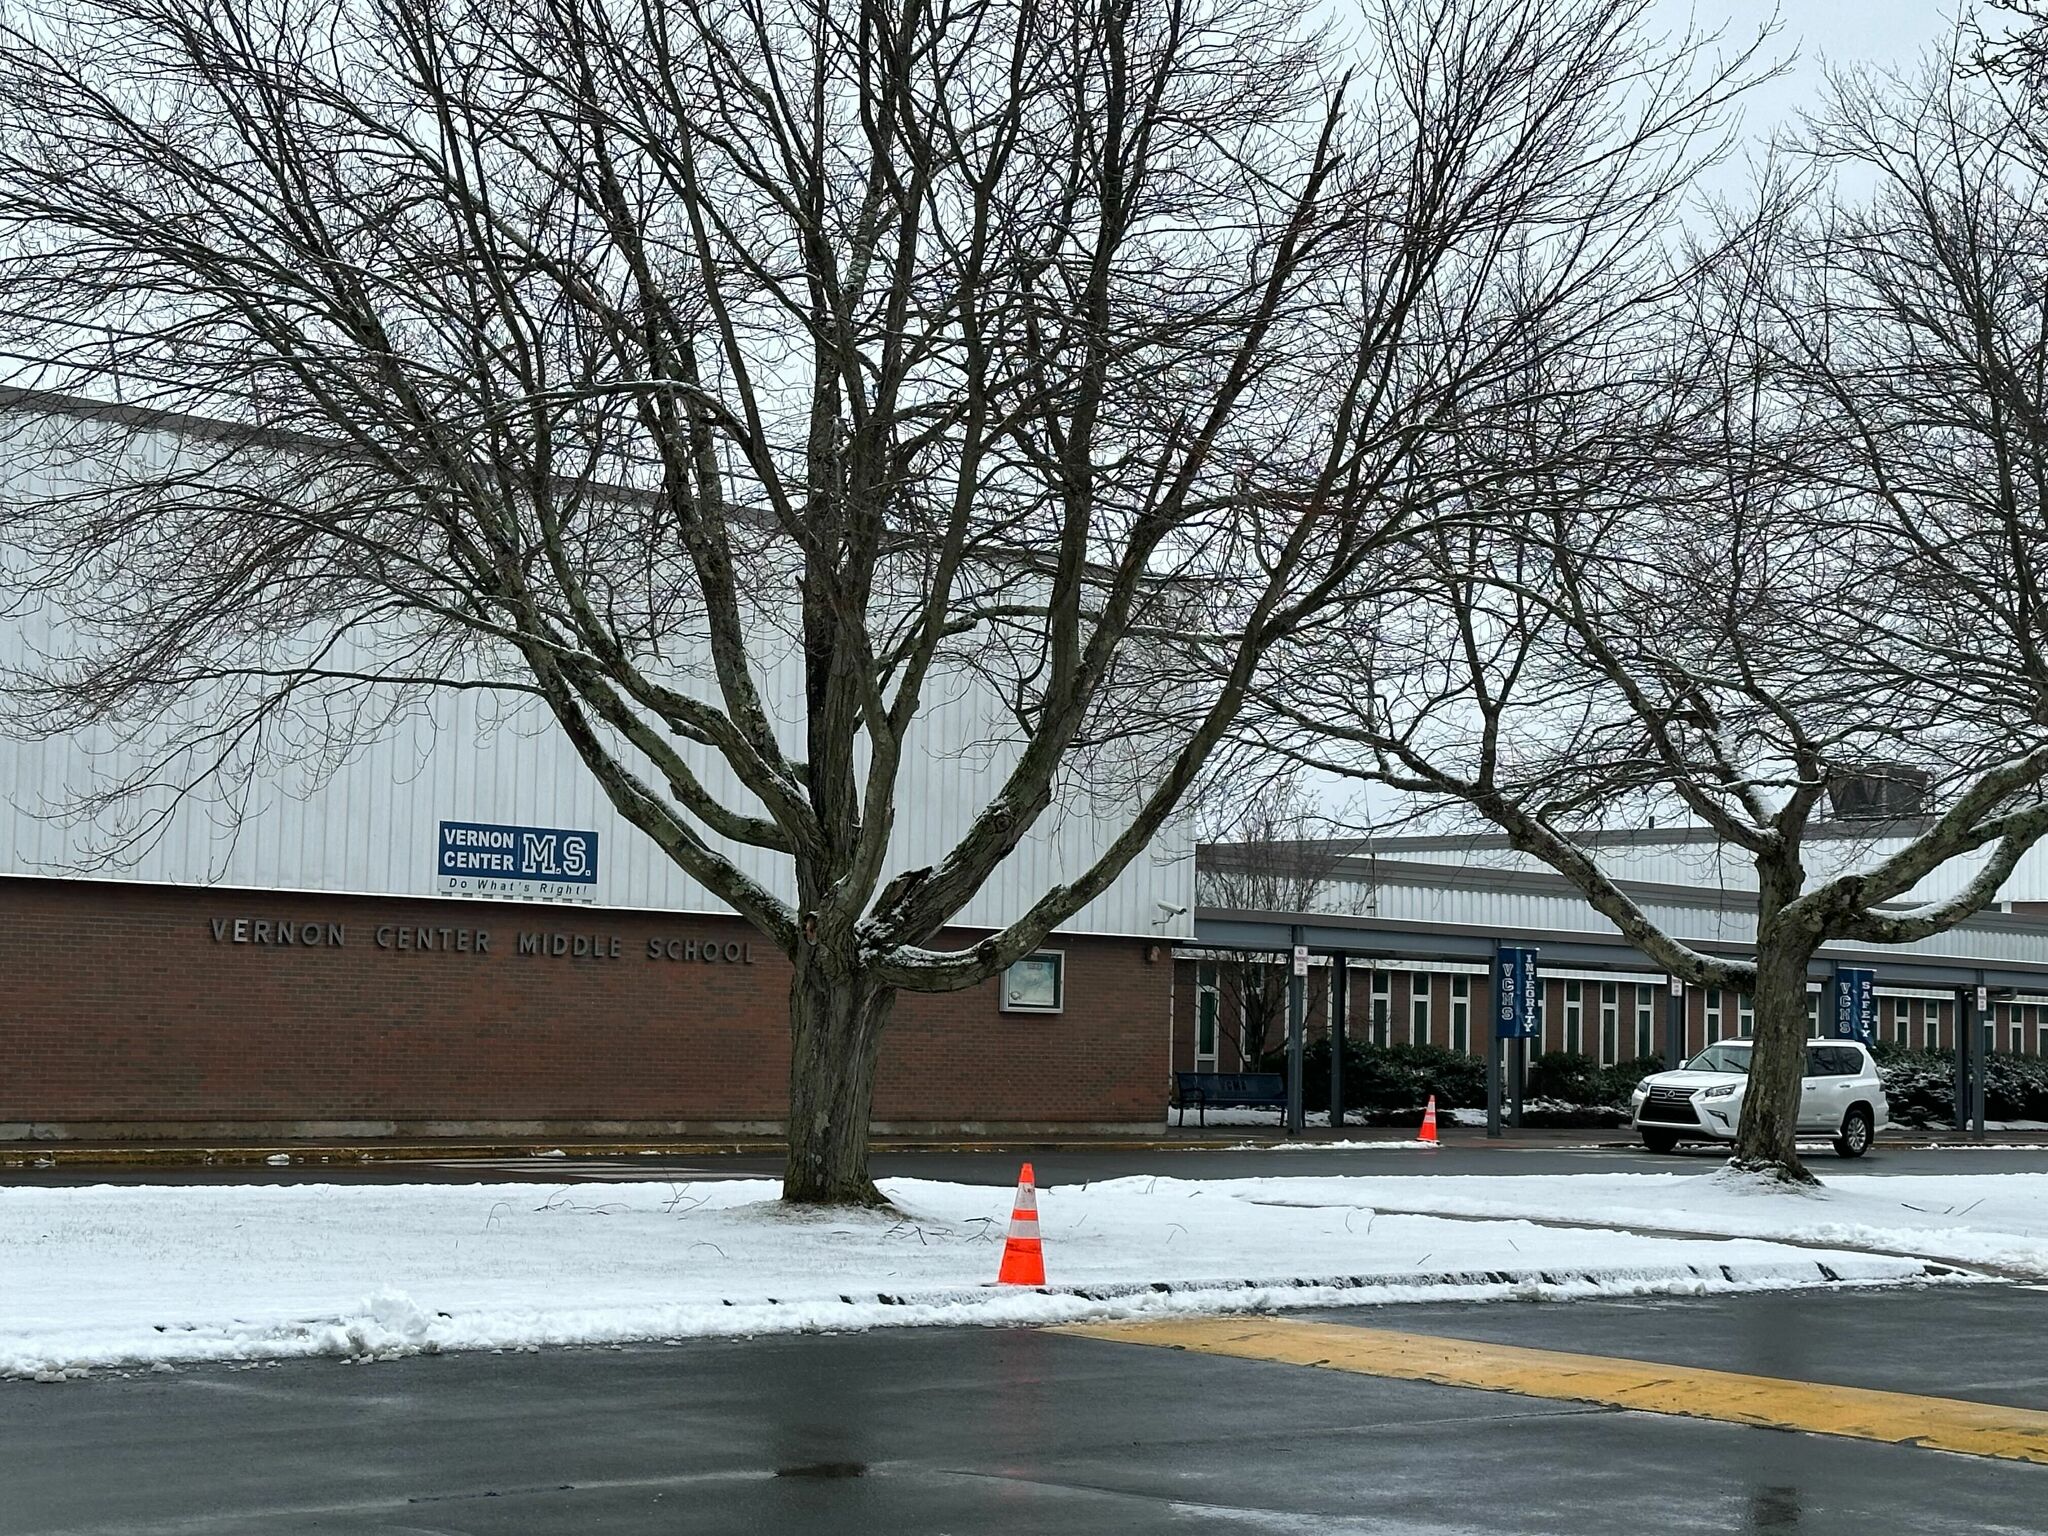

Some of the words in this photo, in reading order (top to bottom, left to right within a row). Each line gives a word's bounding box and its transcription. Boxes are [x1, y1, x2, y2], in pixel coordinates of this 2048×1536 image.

[444, 828, 514, 849] VERNON
[444, 851, 514, 871] CENTER
[522, 833, 591, 877] M.S.
[449, 878, 467, 888] Do
[477, 879, 530, 892] What's
[540, 883, 588, 896] Right!
[211, 917, 345, 946] VERNON
[376, 926, 490, 953] CENTER
[518, 931, 622, 958] MIDDLE
[647, 937, 755, 965] SCHOOL
[1501, 963, 1514, 1021] VCMS
[1523, 954, 1536, 1032] INTEGRITY
[1839, 982, 1852, 1034] VCMS
[1860, 981, 1871, 1038] SAFETY
